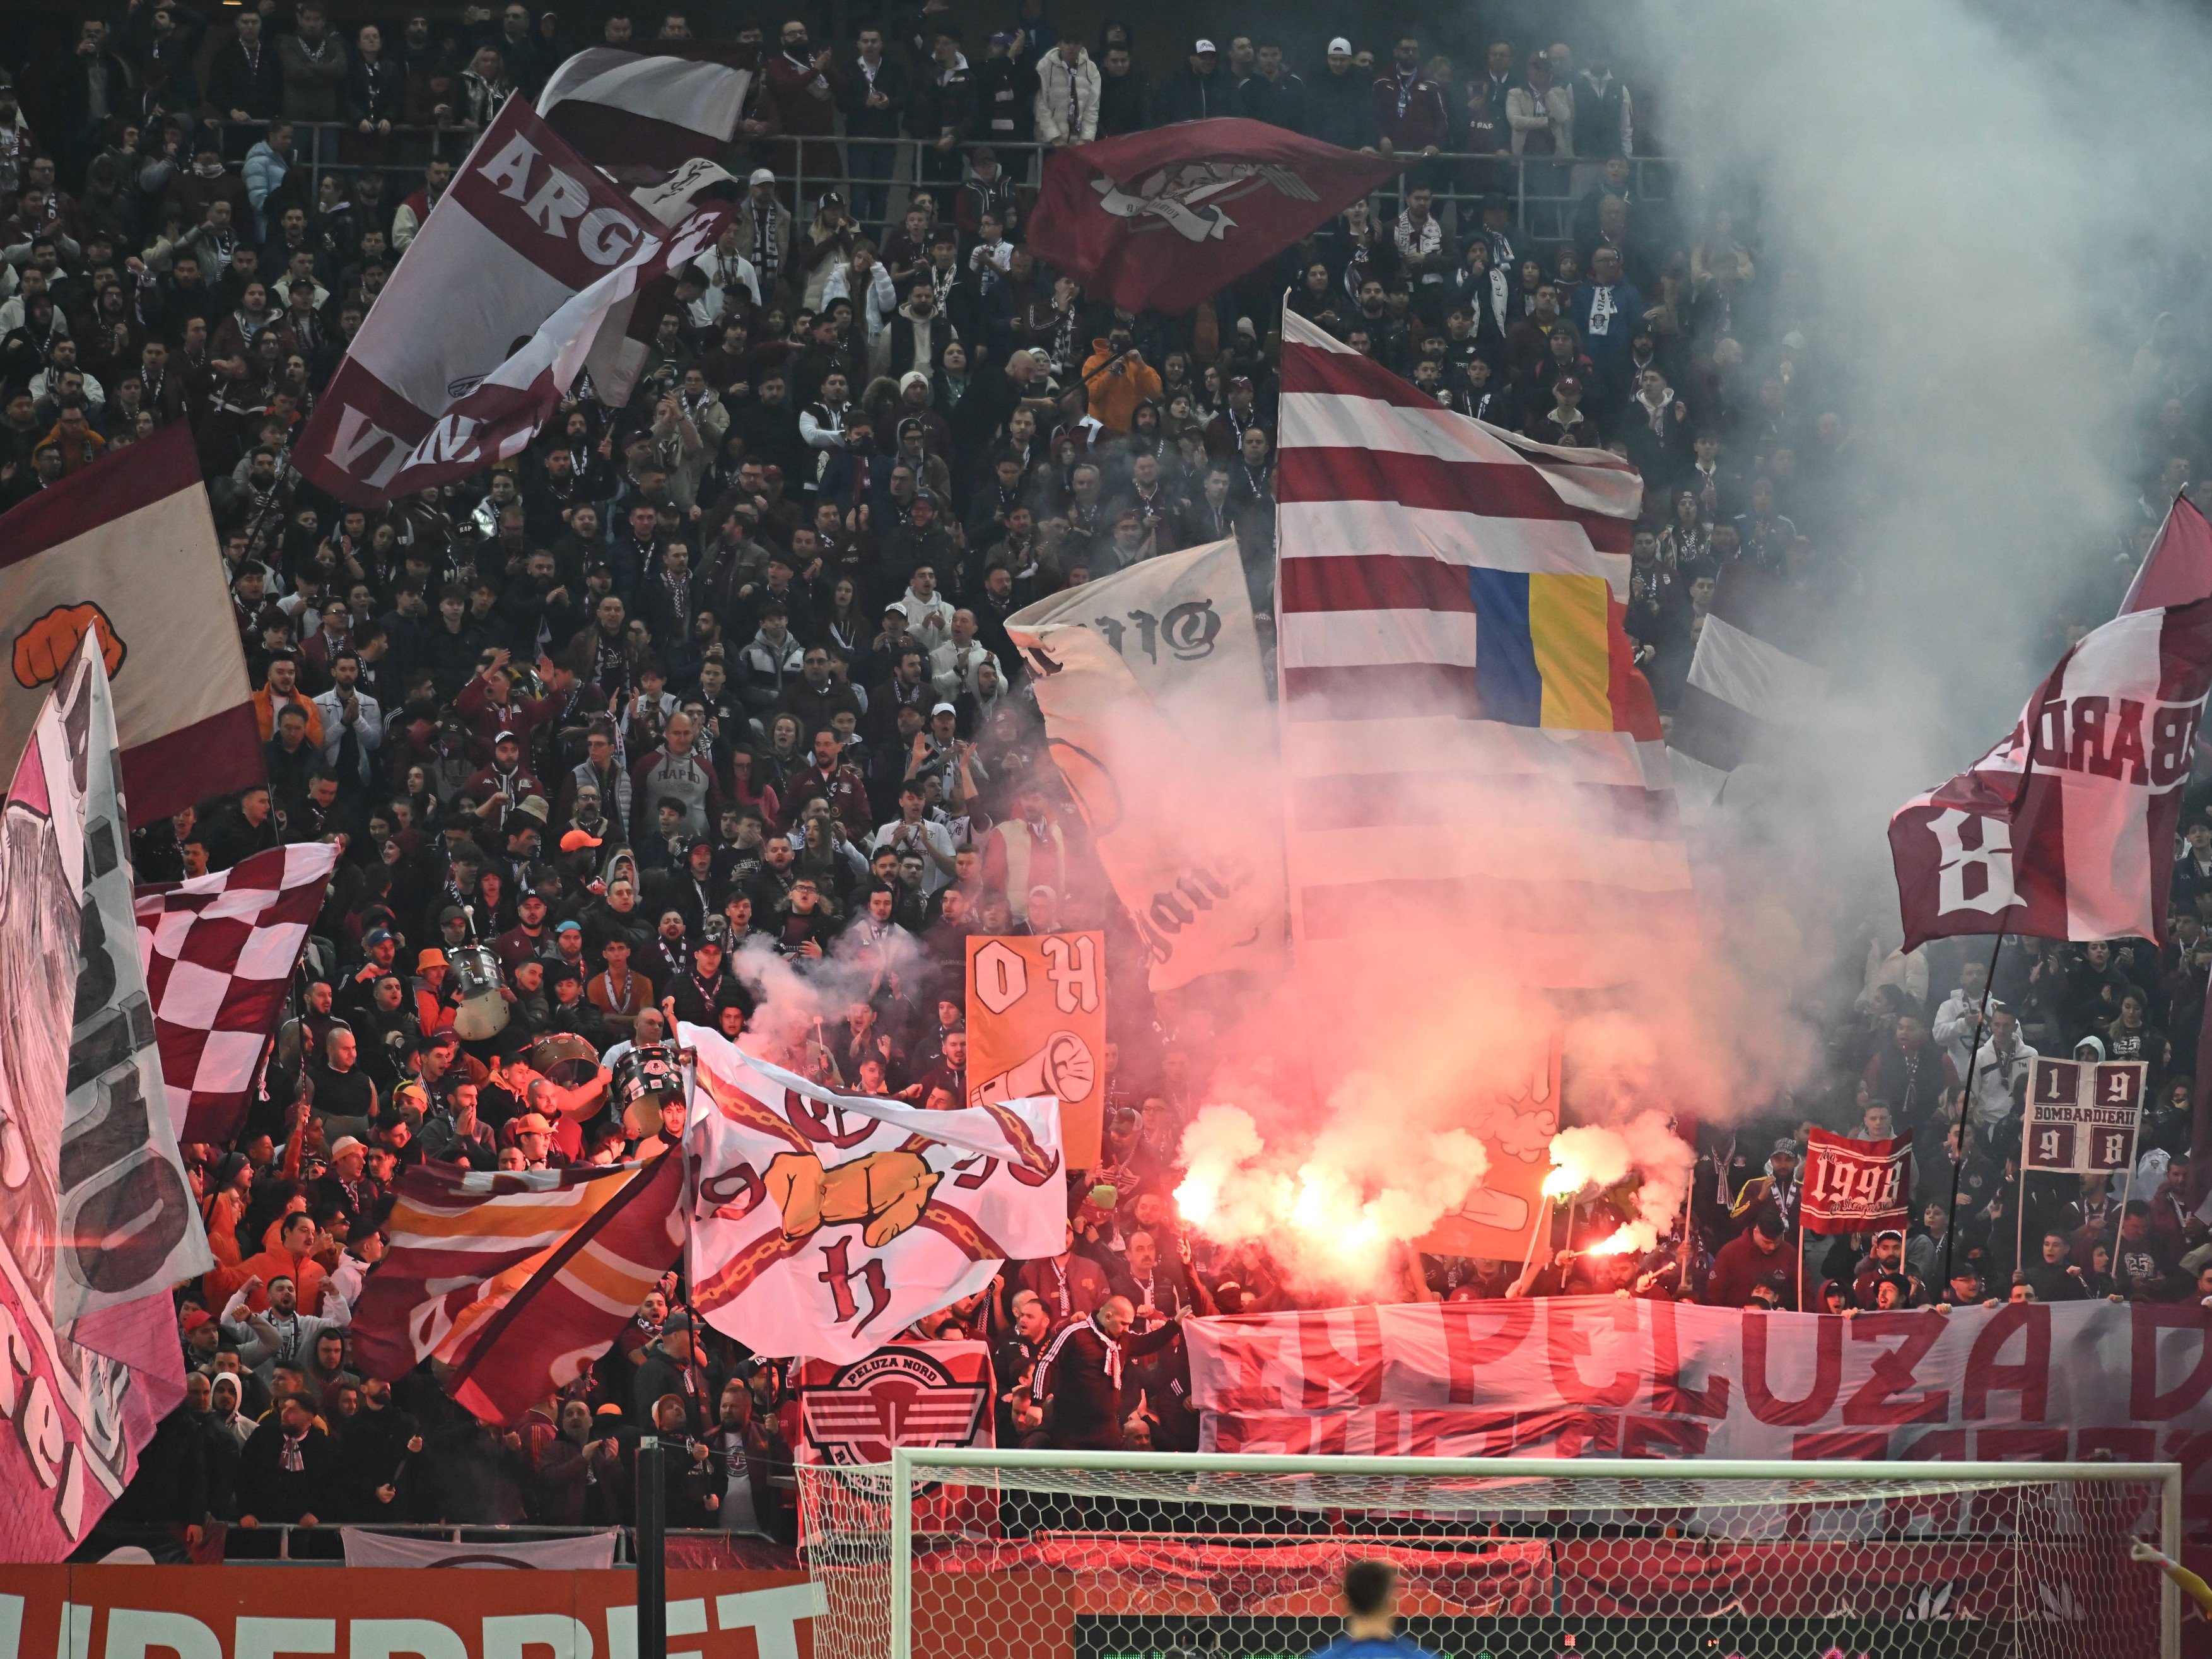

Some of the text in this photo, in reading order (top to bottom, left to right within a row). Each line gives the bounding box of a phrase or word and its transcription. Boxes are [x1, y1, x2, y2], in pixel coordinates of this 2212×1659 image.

[2034, 1106, 2136, 1125] BOMBARDIERII
[1811, 1156, 1903, 1205] 1998
[847, 1357, 937, 1385] PELUZA NORD
[1441, 1297, 2051, 1427] PELUZA
